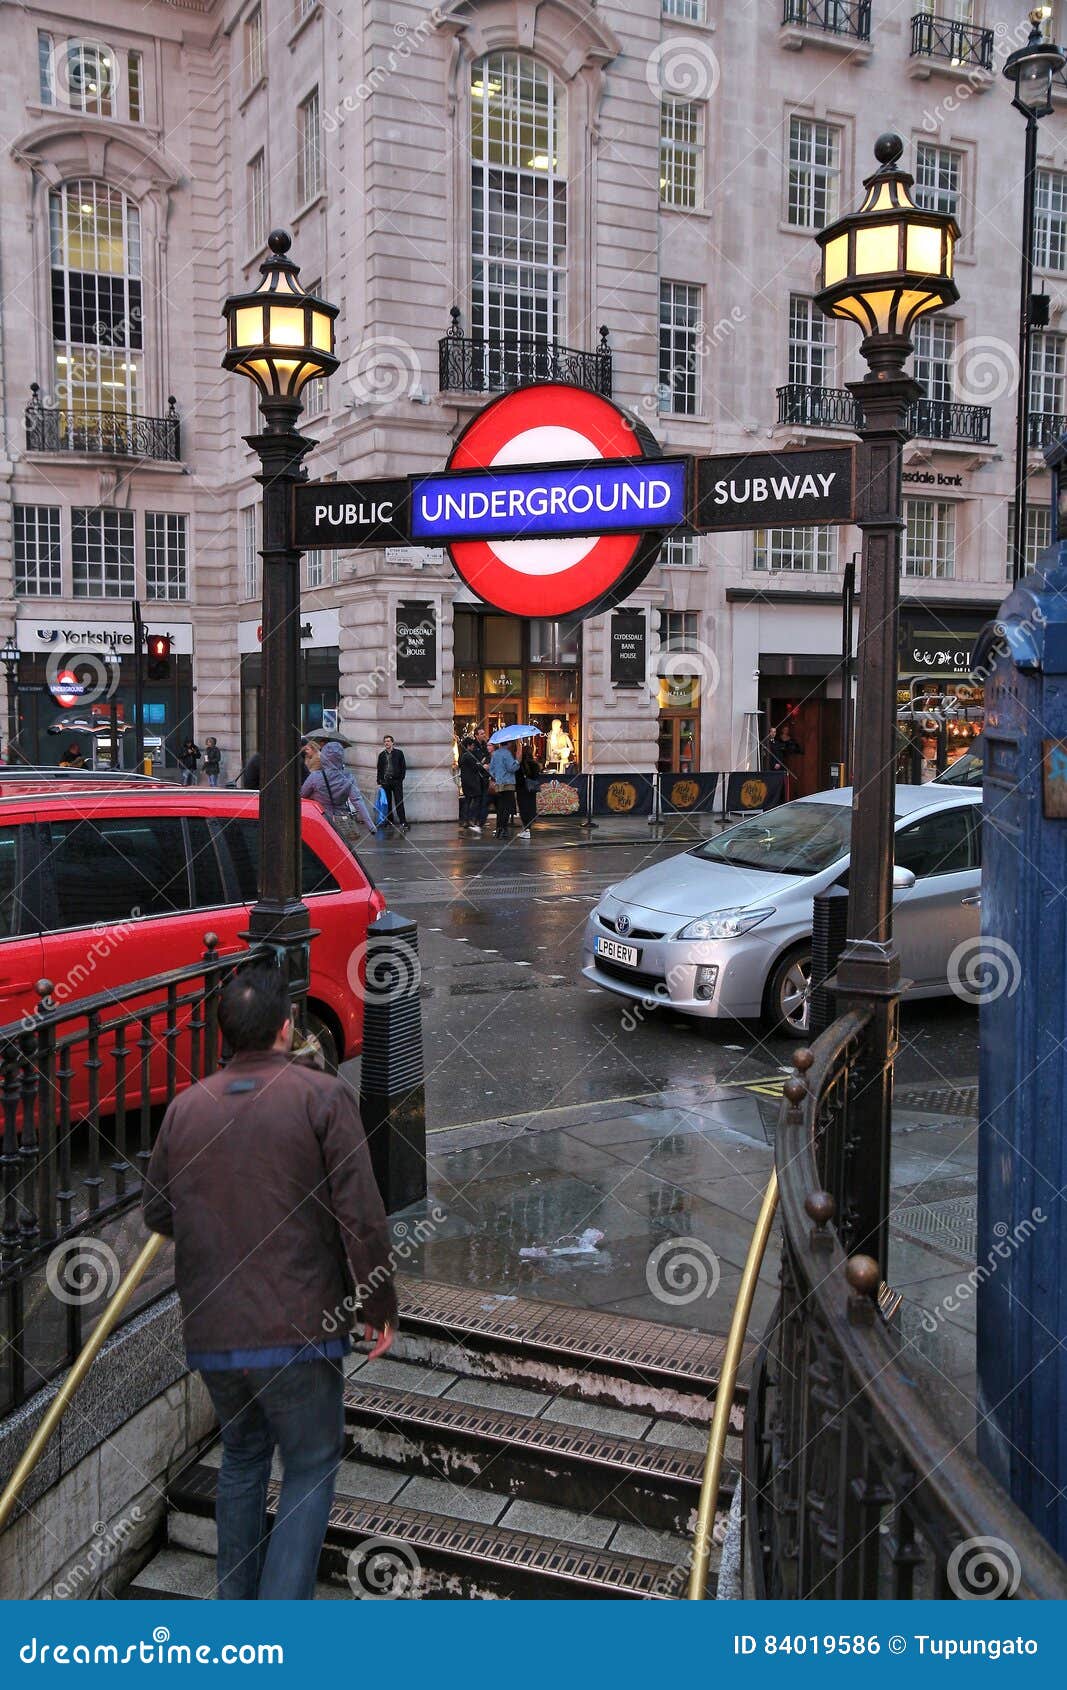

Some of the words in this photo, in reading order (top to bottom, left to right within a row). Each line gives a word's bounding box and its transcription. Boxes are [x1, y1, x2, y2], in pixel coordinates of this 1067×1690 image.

[901, 471, 935, 484] esdale
[938, 473, 963, 486] Bank
[713, 472, 837, 505] SUBWAY
[421, 480, 671, 522] UNDERGROUND
[315, 502, 394, 526] PUBLIC
[61, 630, 133, 645] Yorkshire
[399, 628, 433, 636] CLYDESDALE
[613, 633, 643, 641] CLYDESDALE
[406, 648, 426, 656] HOUSE
[953, 651, 971, 666] CI
[50, 685, 84, 694] UNDERGROUND
